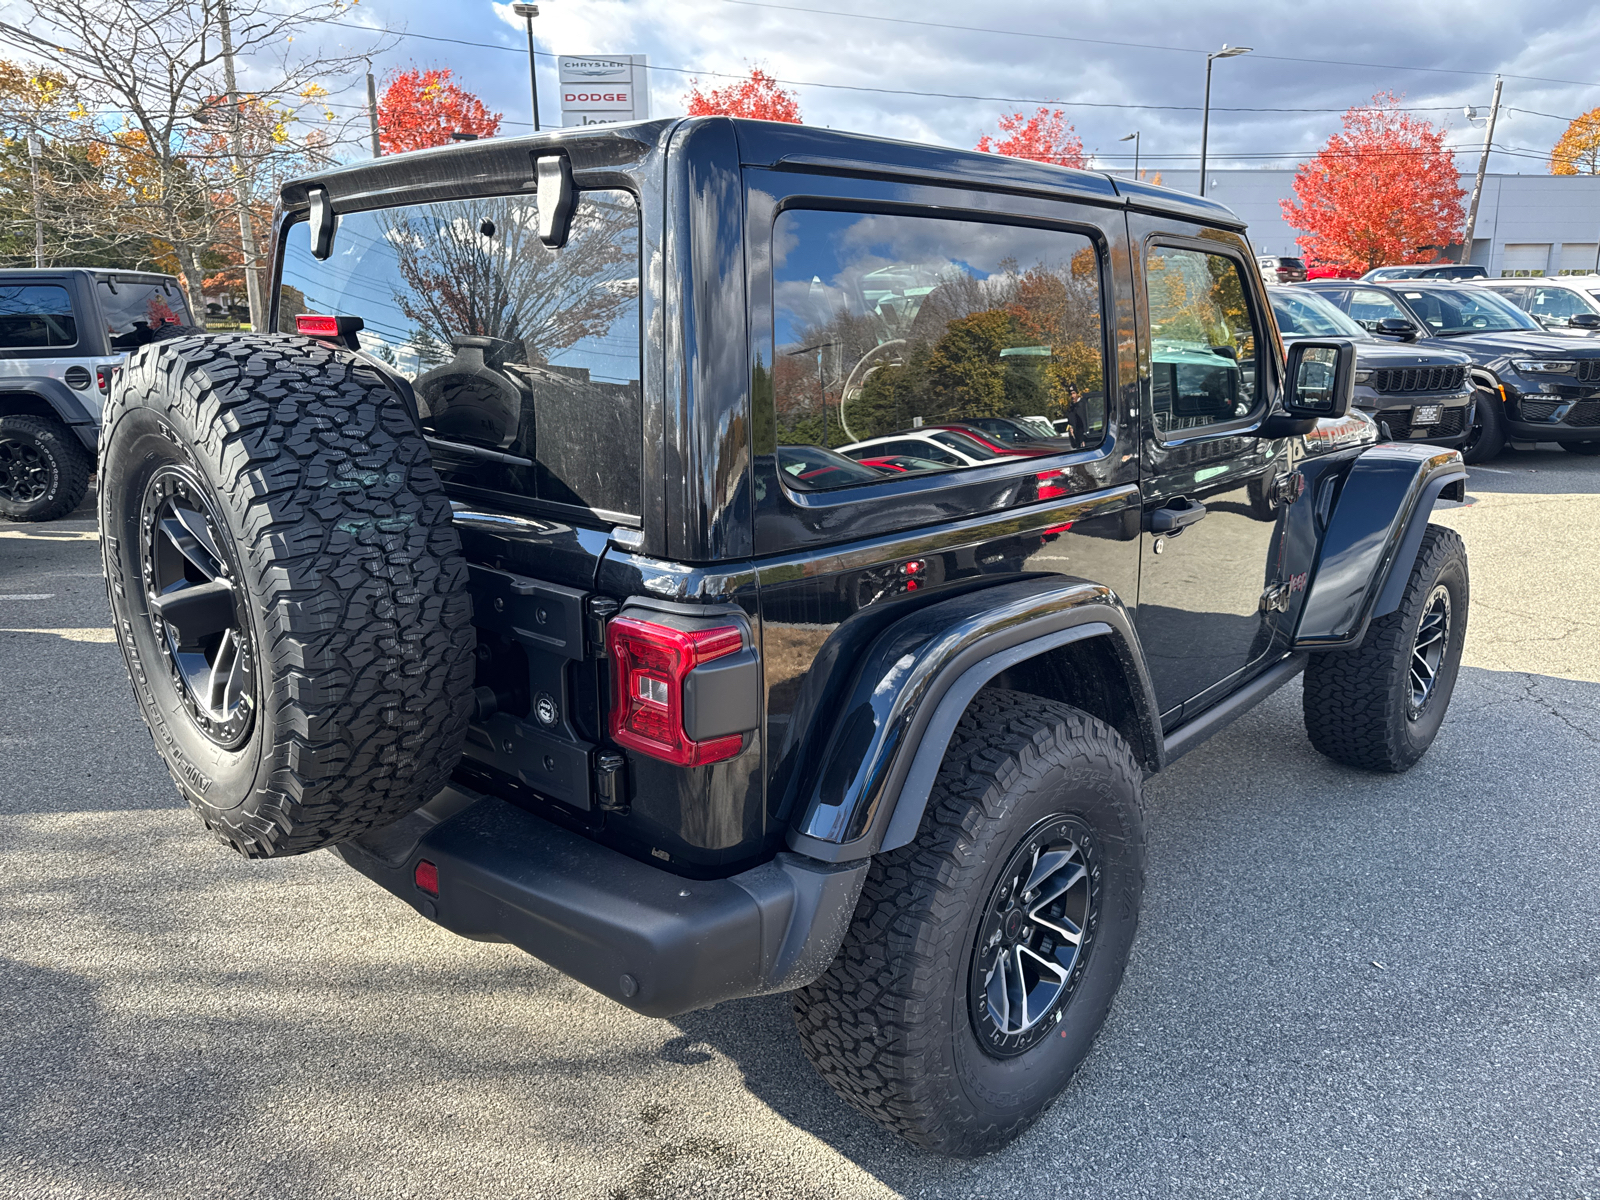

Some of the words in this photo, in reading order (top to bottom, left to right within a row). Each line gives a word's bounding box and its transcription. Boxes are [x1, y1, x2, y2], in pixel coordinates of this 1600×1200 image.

[565, 93, 627, 102] DODGE
[575, 115, 618, 127] Je
[1289, 571, 1307, 592] Jeep
